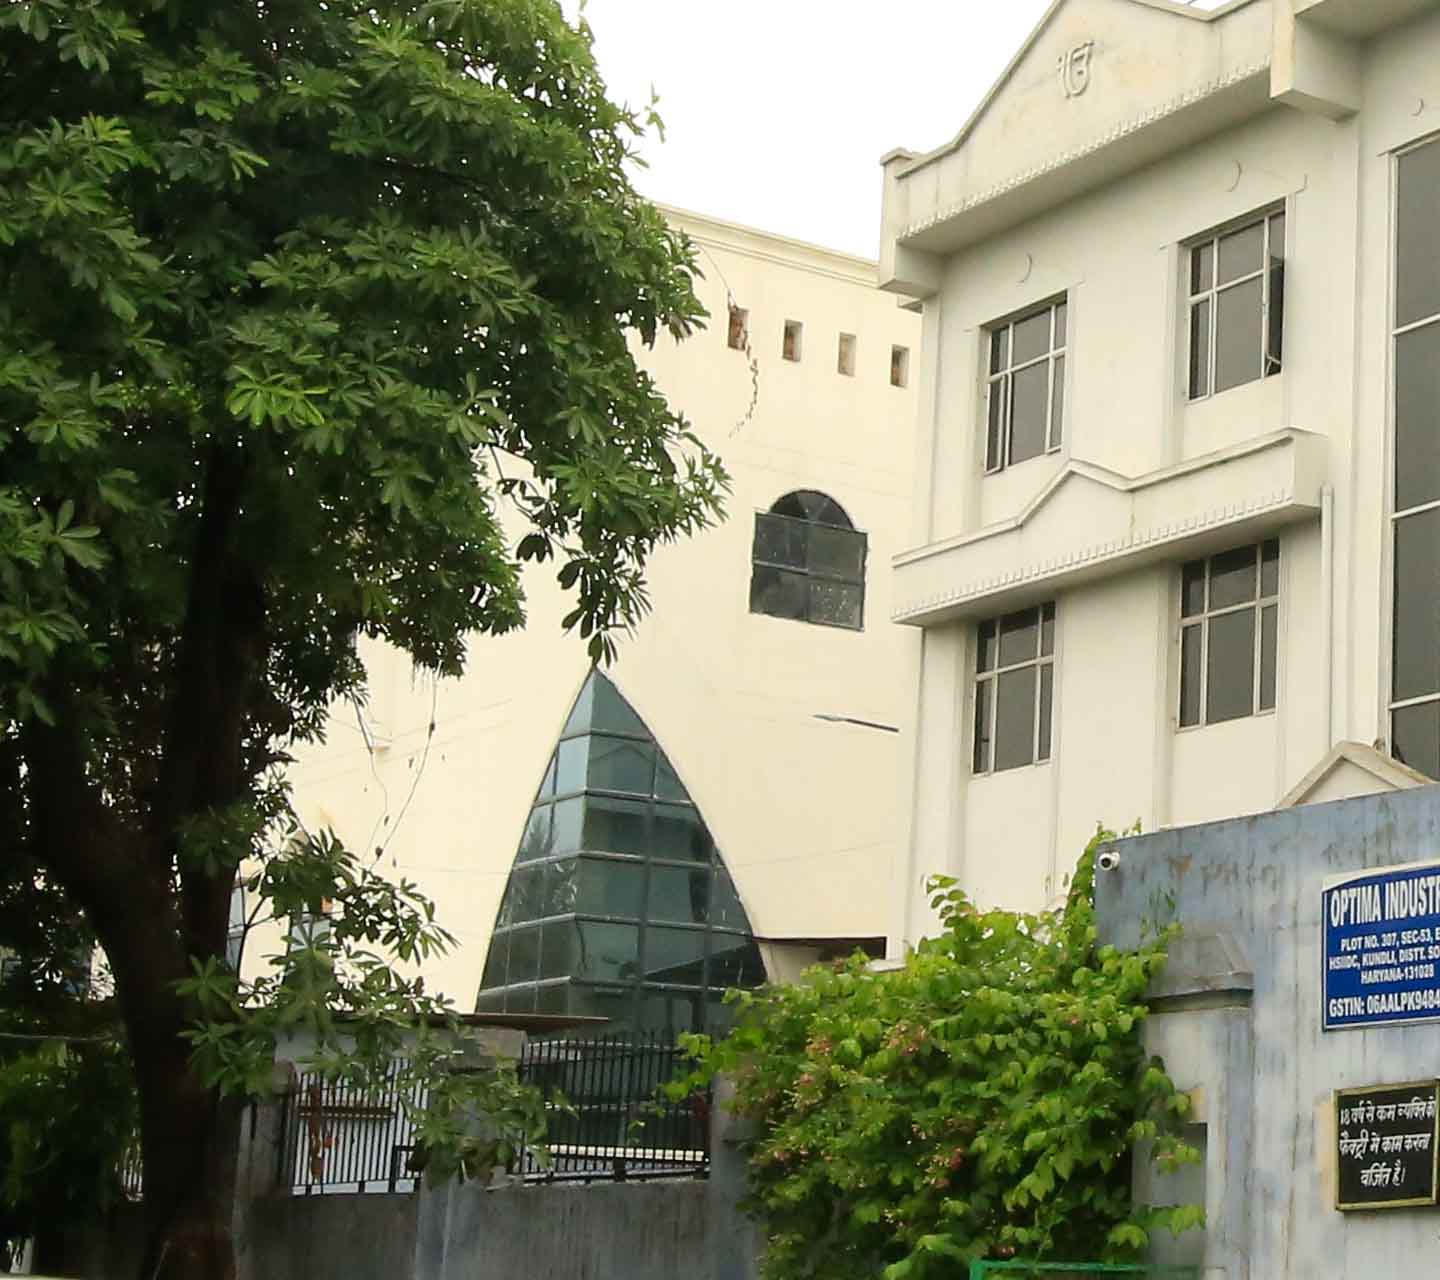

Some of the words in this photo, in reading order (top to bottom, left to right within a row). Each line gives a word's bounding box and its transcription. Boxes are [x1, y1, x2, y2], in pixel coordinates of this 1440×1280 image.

[1330, 884, 1382, 928] OPTIMA
[1340, 936, 1363, 952] PLOT
[1363, 934, 1380, 949] NO.
[1328, 997, 1365, 1017] GSTIN:
[1376, 1104, 1397, 1121] कम
